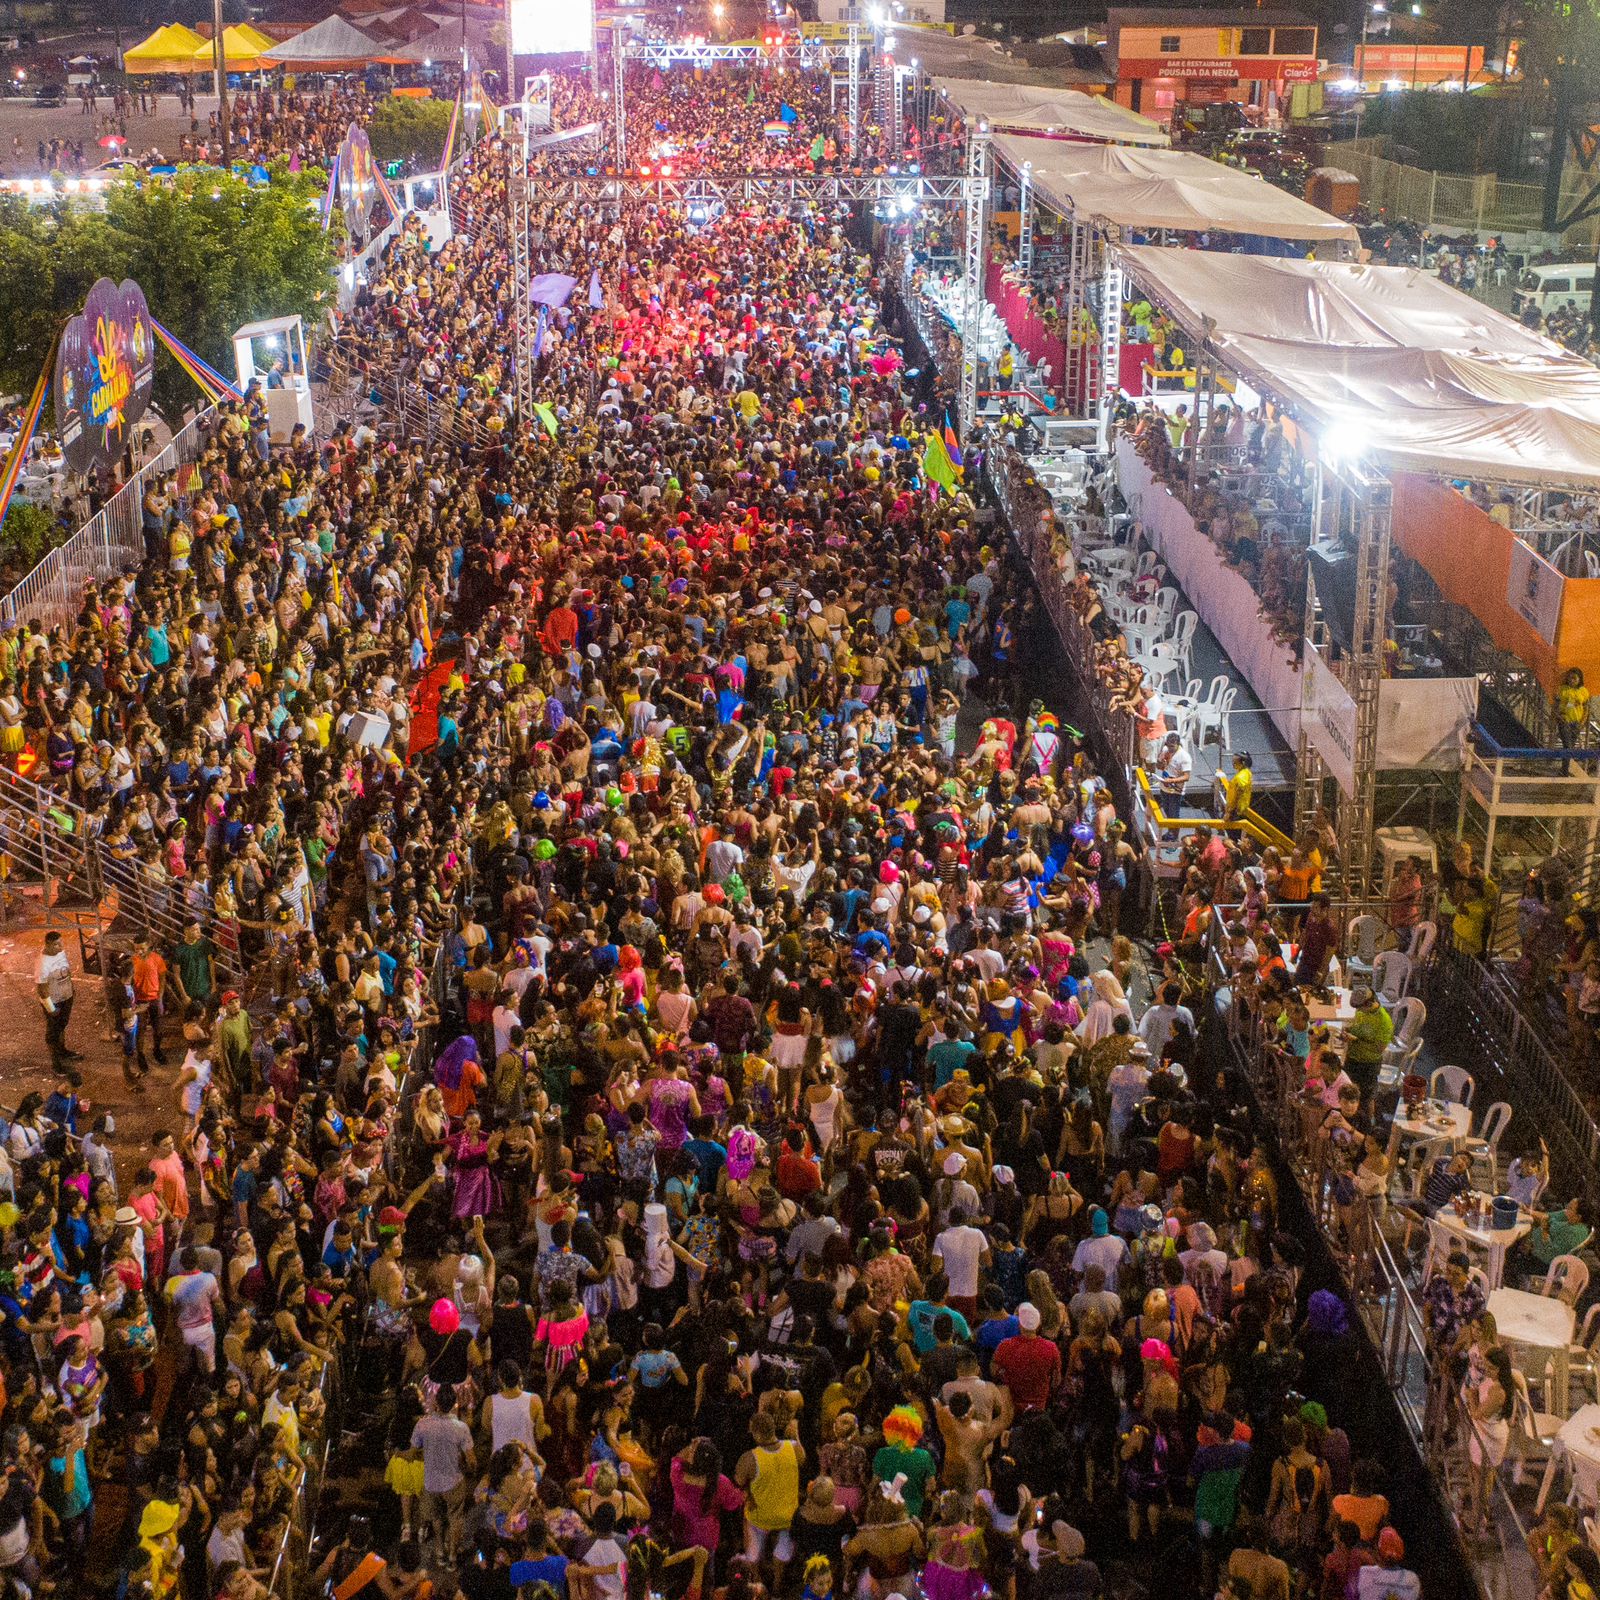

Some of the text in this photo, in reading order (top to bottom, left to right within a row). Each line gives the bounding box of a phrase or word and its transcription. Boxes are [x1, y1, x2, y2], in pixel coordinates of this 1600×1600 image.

[1159, 69, 1239, 77] POUSADA DA NEUZA
[1284, 67, 1309, 77] Claro
[1232, 447, 1247, 457] 06
[676, 736, 685, 750] 5
